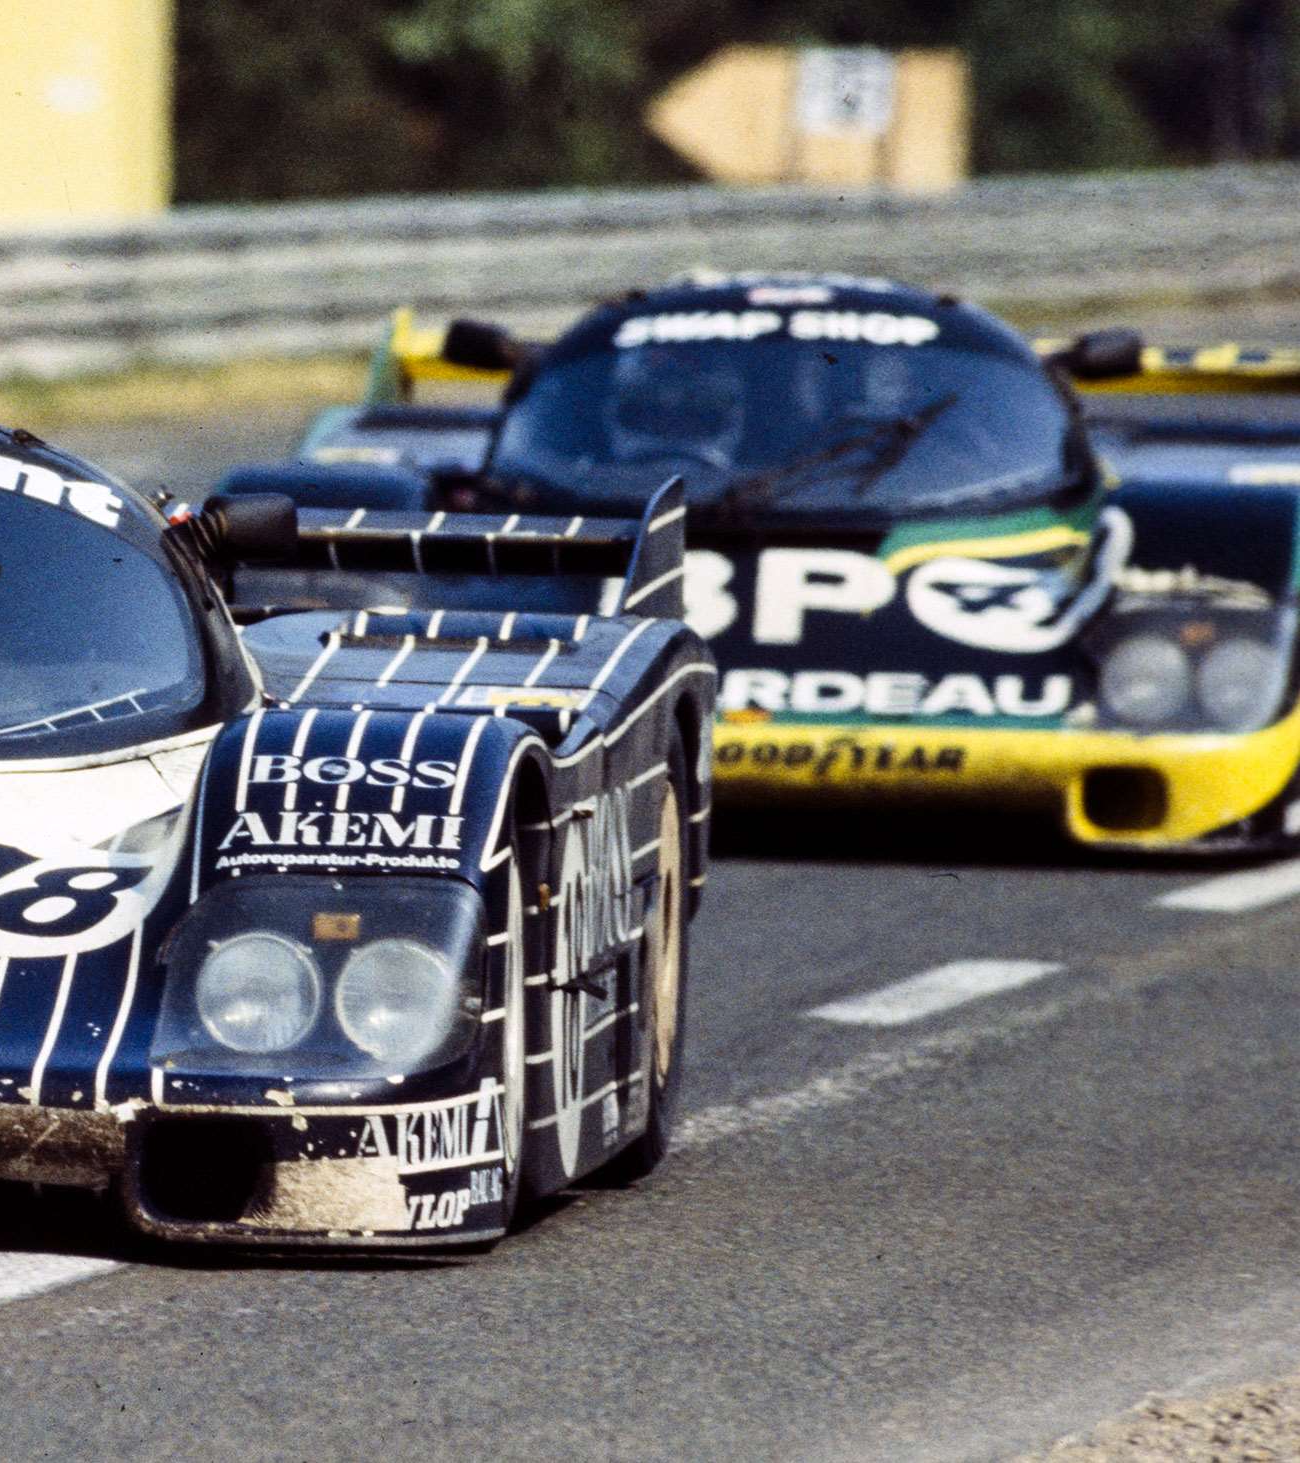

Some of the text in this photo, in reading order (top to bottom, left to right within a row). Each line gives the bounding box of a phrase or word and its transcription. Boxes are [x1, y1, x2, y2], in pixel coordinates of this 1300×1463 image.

[789, 309, 938, 346] SHOP
[717, 667, 1073, 718] RDEAU
[248, 754, 460, 789] BOSS
[715, 736, 967, 778] OODYEAR
[216, 810, 467, 851] AKEMI
